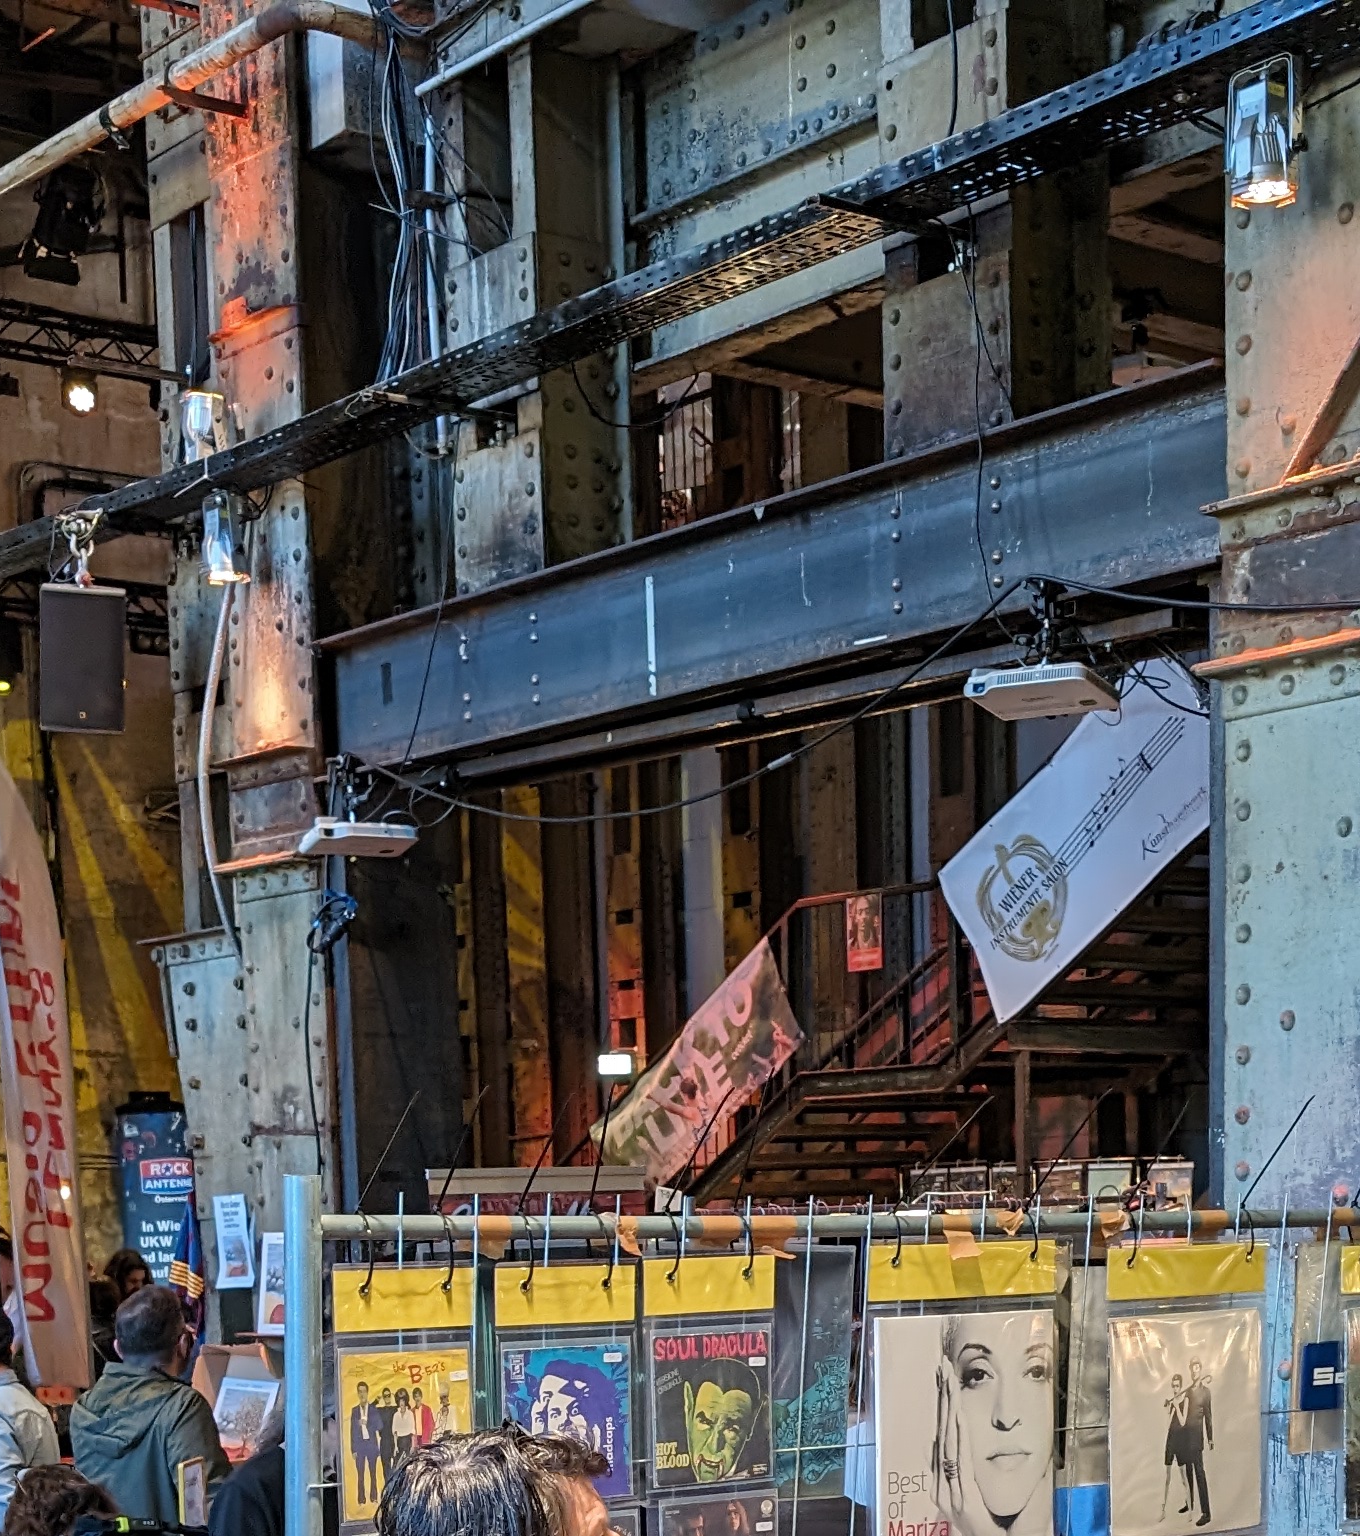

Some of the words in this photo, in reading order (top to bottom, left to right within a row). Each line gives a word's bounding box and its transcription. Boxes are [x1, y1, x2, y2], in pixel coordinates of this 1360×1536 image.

[998, 867, 1039, 913] WIENER
[989, 888, 1045, 950] INSTRUMENTE
[1041, 858, 1069, 892] SALON
[699, 979, 752, 1048] TO
[150, 1163, 189, 1175] ROCK
[142, 1221, 153, 1232] In
[140, 1236, 172, 1248] UKW
[655, 1334, 698, 1361] SOUL
[703, 1328, 767, 1358] DRACULA
[655, 1441, 677, 1456] HOT
[656, 1454, 690, 1469] BLOOD
[888, 1471, 927, 1494] Best
[888, 1495, 906, 1519] of
